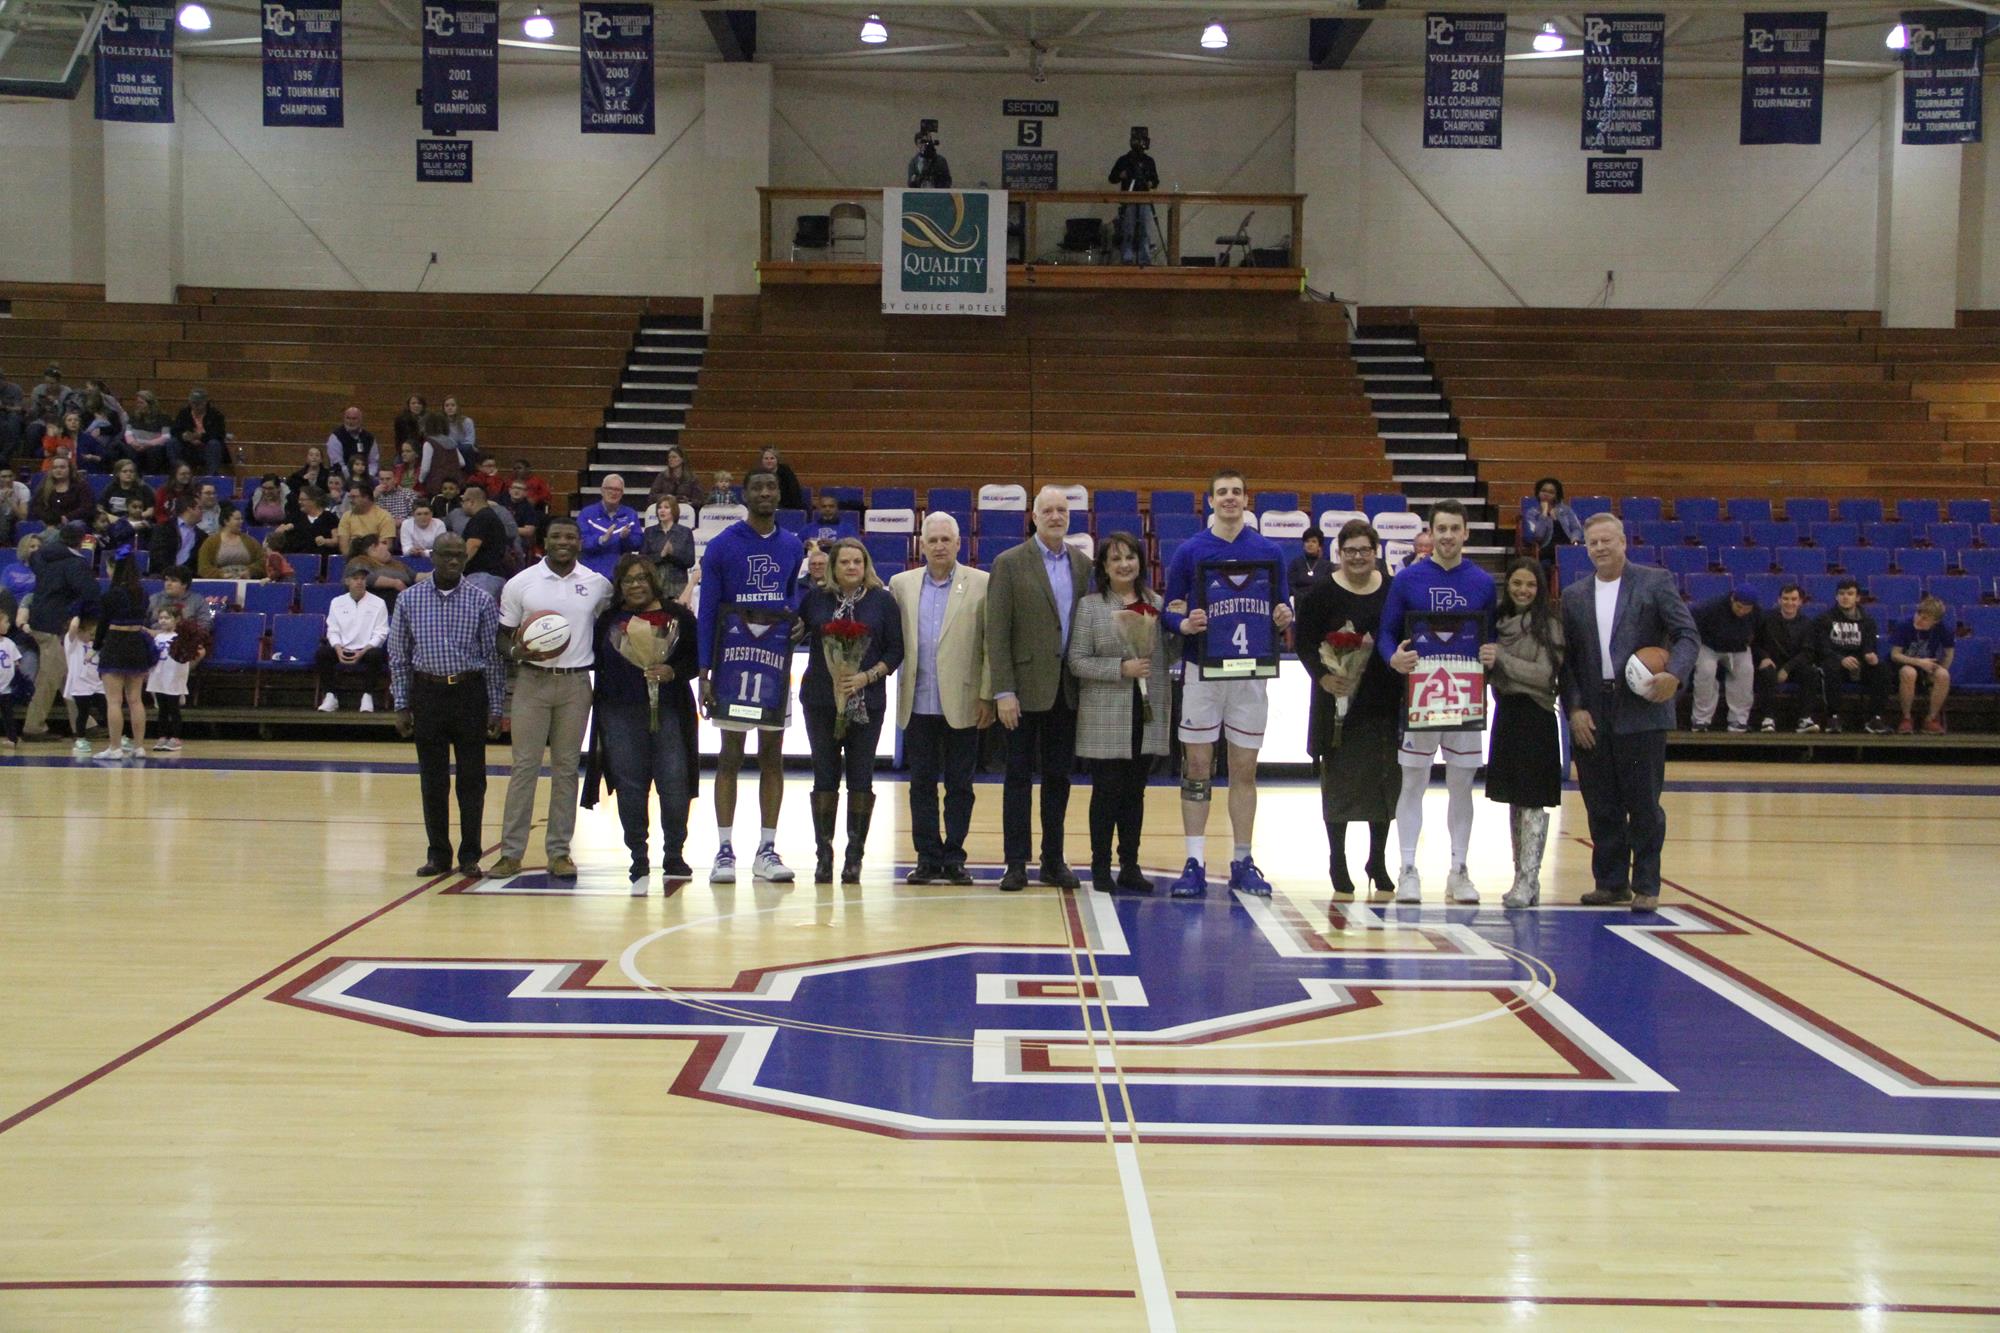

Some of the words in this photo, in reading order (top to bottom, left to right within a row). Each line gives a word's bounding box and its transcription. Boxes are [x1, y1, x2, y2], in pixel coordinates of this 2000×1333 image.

[99, 45, 173, 57] VOLLEYBALL
[268, 49, 338, 59] VOLLEYBALL
[588, 50, 648, 60] VOLLEYBALL
[1429, 54, 1502, 63] VOLLEYBALL
[1586, 56, 1661, 65] VOLLEYBALL
[293, 71, 312, 81] 1996
[449, 69, 471, 81] 2001
[606, 68, 629, 79] 2003
[1451, 69, 1480, 80] 2004
[117, 74, 136, 83] 1994
[141, 75, 156, 84] SAC
[110, 85, 162, 95] TOURNAMENT
[1452, 81, 1478, 92] 28-8
[267, 86, 282, 97] SAC
[288, 87, 340, 98] TOURNAMENT
[451, 89, 469, 100] SAC
[1950, 87, 1964, 97] SAC
[113, 96, 160, 106] CHAMPIONS
[1752, 98, 1812, 108] TOURNAMENT
[1915, 98, 1964, 108] TOURNAMENT
[280, 104, 327, 115] CHAMPIONS
[434, 103, 487, 114] CHAMPIONS
[1007, 103, 1054, 113] SECTION
[592, 113, 645, 125] CHAMPIONS
[1451, 109, 1498, 119] TOURNAMENT
[1608, 110, 1655, 120] TOURNAMENT
[1917, 110, 1961, 120] CHAMPIONS
[1443, 121, 1485, 132] CHAMPIONS
[1600, 121, 1642, 132] CHAMPIONS
[1926, 121, 1975, 131] TOURNAMENT
[1023, 124, 1037, 143] 5
[1428, 135, 1449, 145] NCAA
[1450, 135, 1497, 145] TOURNAMENT
[1607, 135, 1655, 146] TOURNAMENT
[423, 152, 449, 160] SEATS
[1592, 161, 1638, 170] RESERVED
[1595, 170, 1634, 179] STUDENT
[1595, 179, 1634, 188] SECTION
[904, 252, 984, 275] QUALITY
[929, 276, 959, 286] INN
[905, 303, 950, 311] CHOICE
[960, 304, 1006, 313] HOTELS
[747, 555, 780, 592] PC
[736, 593, 784, 602] BASKETBALL
[1209, 598, 1270, 618] PRESBYTERIAN
[1232, 624, 1249, 655] 4
[724, 646, 785, 670] PRESBYTERIAN
[738, 671, 762, 703] 11
